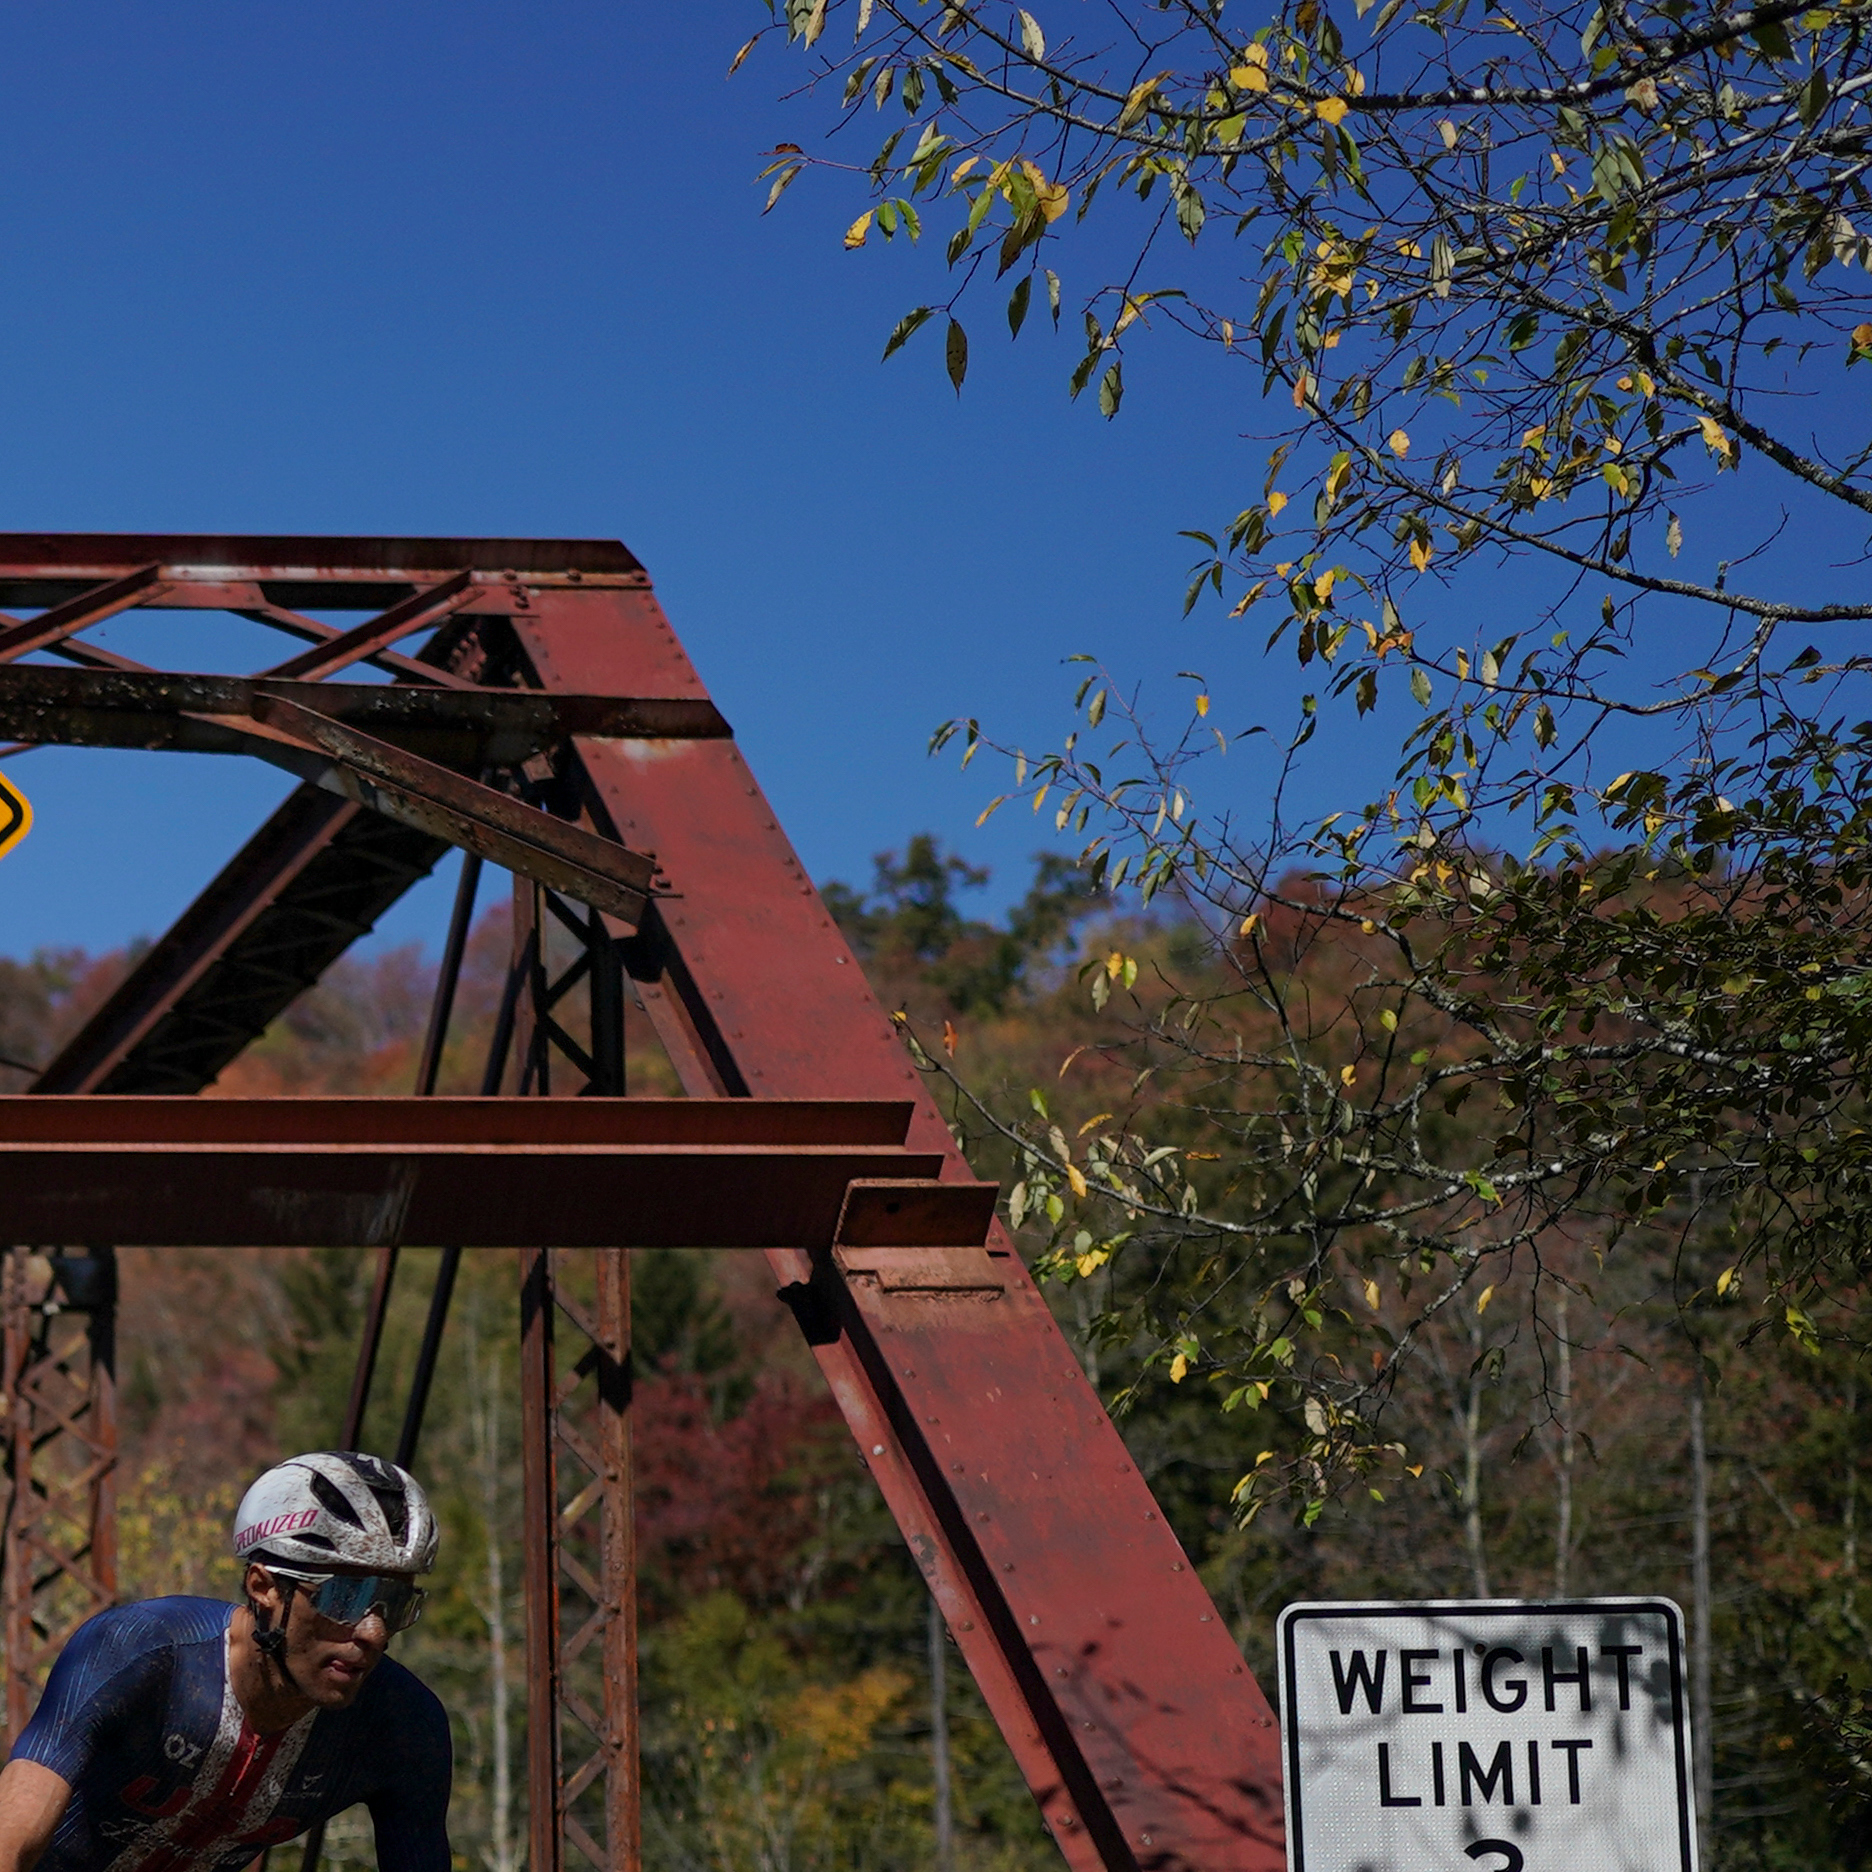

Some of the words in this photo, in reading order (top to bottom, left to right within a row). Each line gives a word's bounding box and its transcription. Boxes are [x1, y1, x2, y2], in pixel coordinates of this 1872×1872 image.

[235, 1508, 319, 1552] SPECIALIZED
[1328, 1645, 1644, 1715] WEIGHT
[1377, 1738, 1594, 1808] LIMIT
